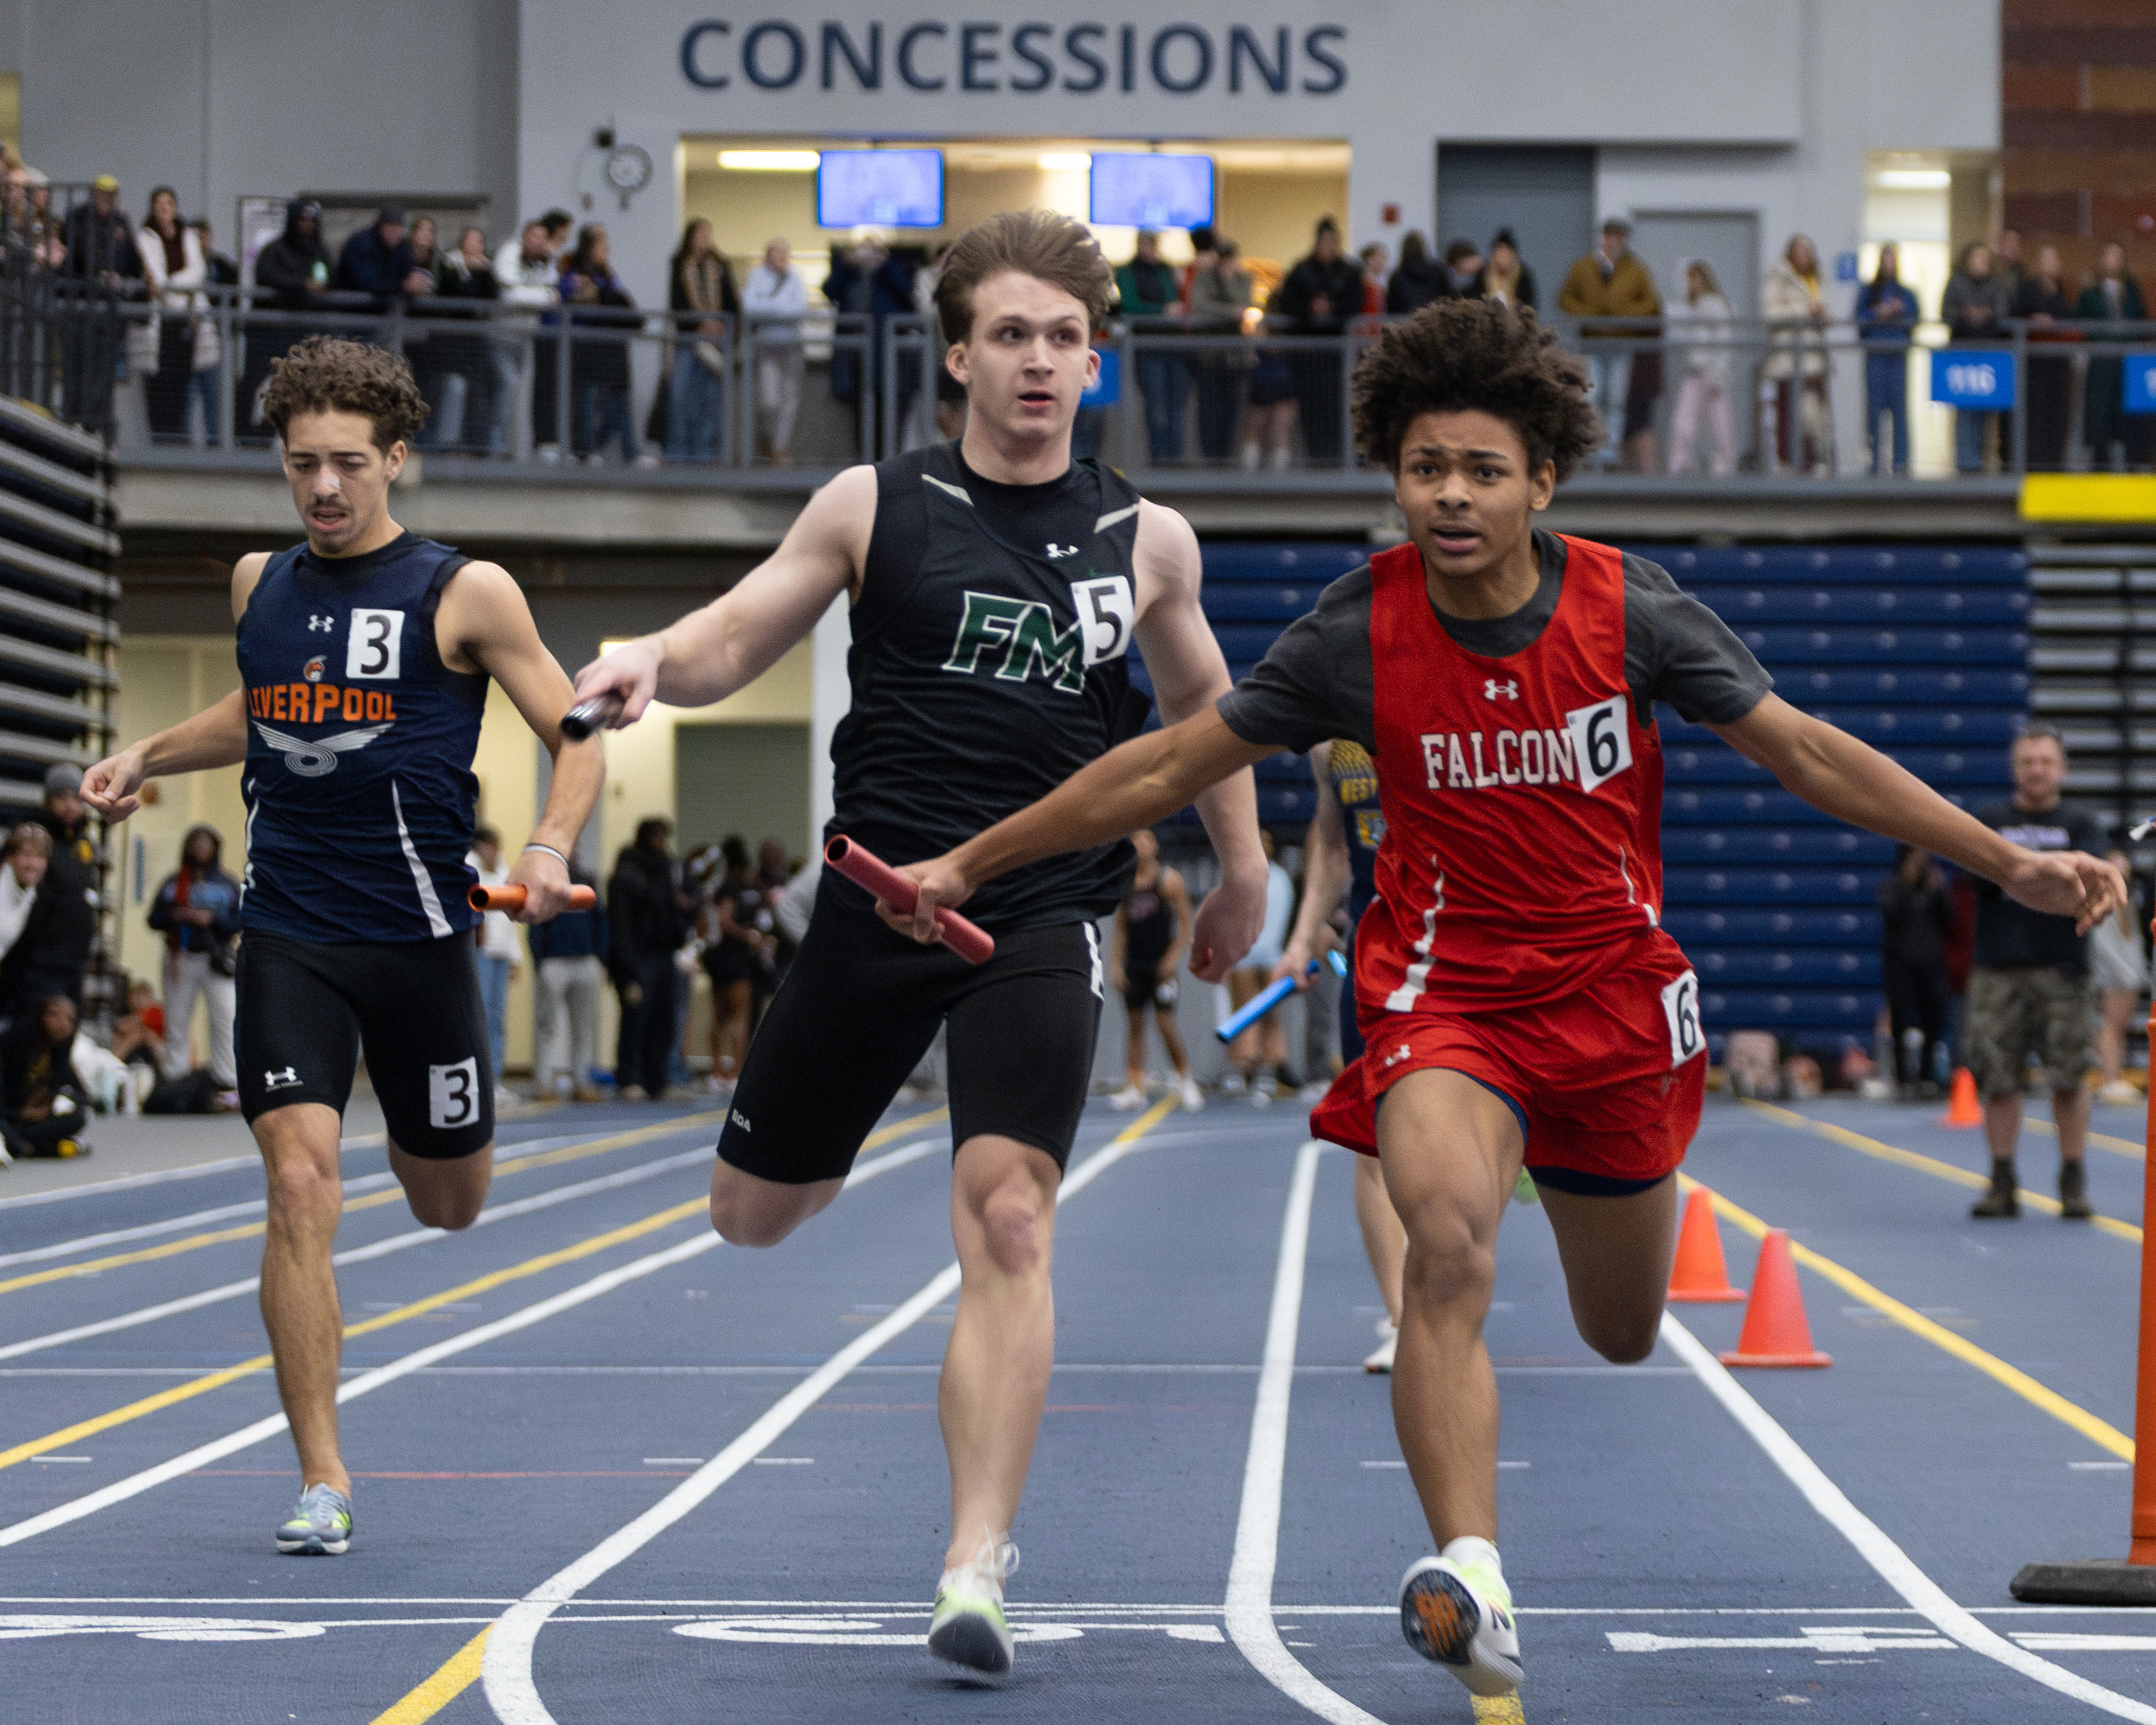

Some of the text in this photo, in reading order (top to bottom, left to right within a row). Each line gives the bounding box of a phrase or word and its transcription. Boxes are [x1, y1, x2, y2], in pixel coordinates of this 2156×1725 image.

[681, 18, 1349, 95] CONCESSIONS
[360, 615, 391, 675] 3
[941, 590, 1085, 695] FM
[1089, 584, 1122, 659] 5
[1587, 706, 1619, 777] 6
[1678, 981, 1696, 1056] 6
[444, 1068, 471, 1124] 3
